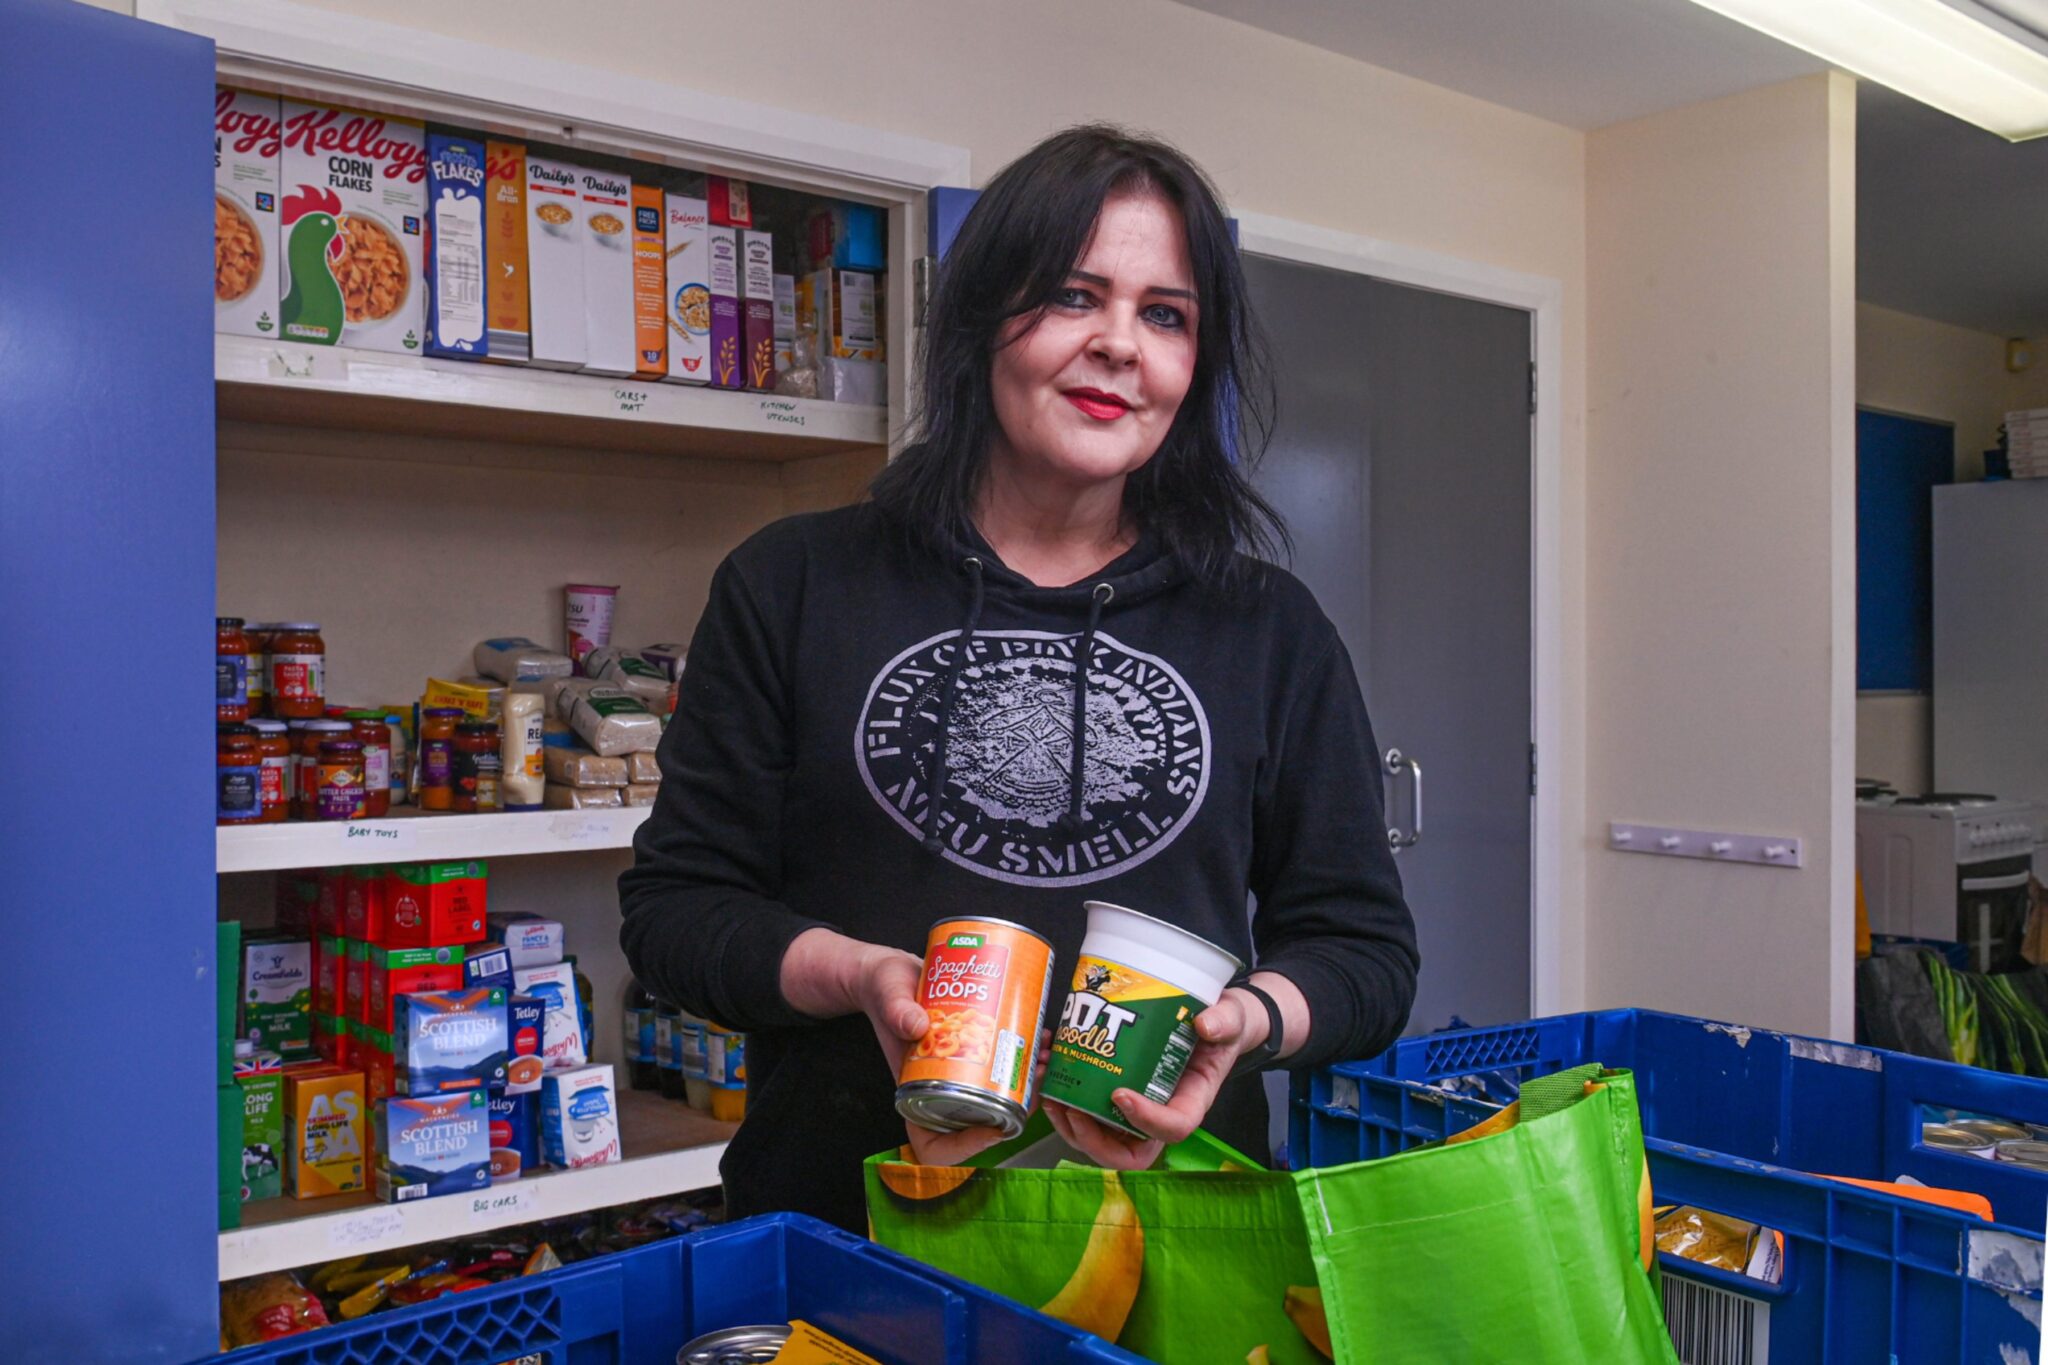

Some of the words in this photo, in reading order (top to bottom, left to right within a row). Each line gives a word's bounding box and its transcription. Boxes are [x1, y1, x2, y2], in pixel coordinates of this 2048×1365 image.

[328, 156, 373, 179] CORN
[431, 160, 485, 188] FLAKES
[529, 164, 576, 186] Daily's
[329, 174, 373, 193] FLAKES
[582, 175, 628, 197] Daily's
[669, 208, 706, 225] Balance
[620, 402, 645, 413] MAT
[868, 660, 936, 759] FLUX
[932, 639, 988, 667] OF
[1001, 638, 1112, 669] PINK
[1115, 657, 1201, 800] INDIANS
[348, 827, 371, 838] BABY
[375, 829, 399, 840] TOYS
[998, 811, 1174, 875] SMELL
[951, 936, 979, 947] ASDA
[927, 954, 1002, 983] Spaghetti
[928, 981, 988, 1001] LOOPS
[514, 1006, 541, 1022] Tetley
[418, 1017, 498, 1038] SCOTTISH
[432, 1033, 488, 1050] BLEND
[1070, 1049, 1123, 1076] MUSHROOM
[244, 1103, 269, 1115] LIFE
[400, 1120, 479, 1144] SCOTTISH
[414, 1137, 468, 1156] BLEND
[473, 1199, 489, 1213] BIG
[493, 1196, 518, 1208] CARS
